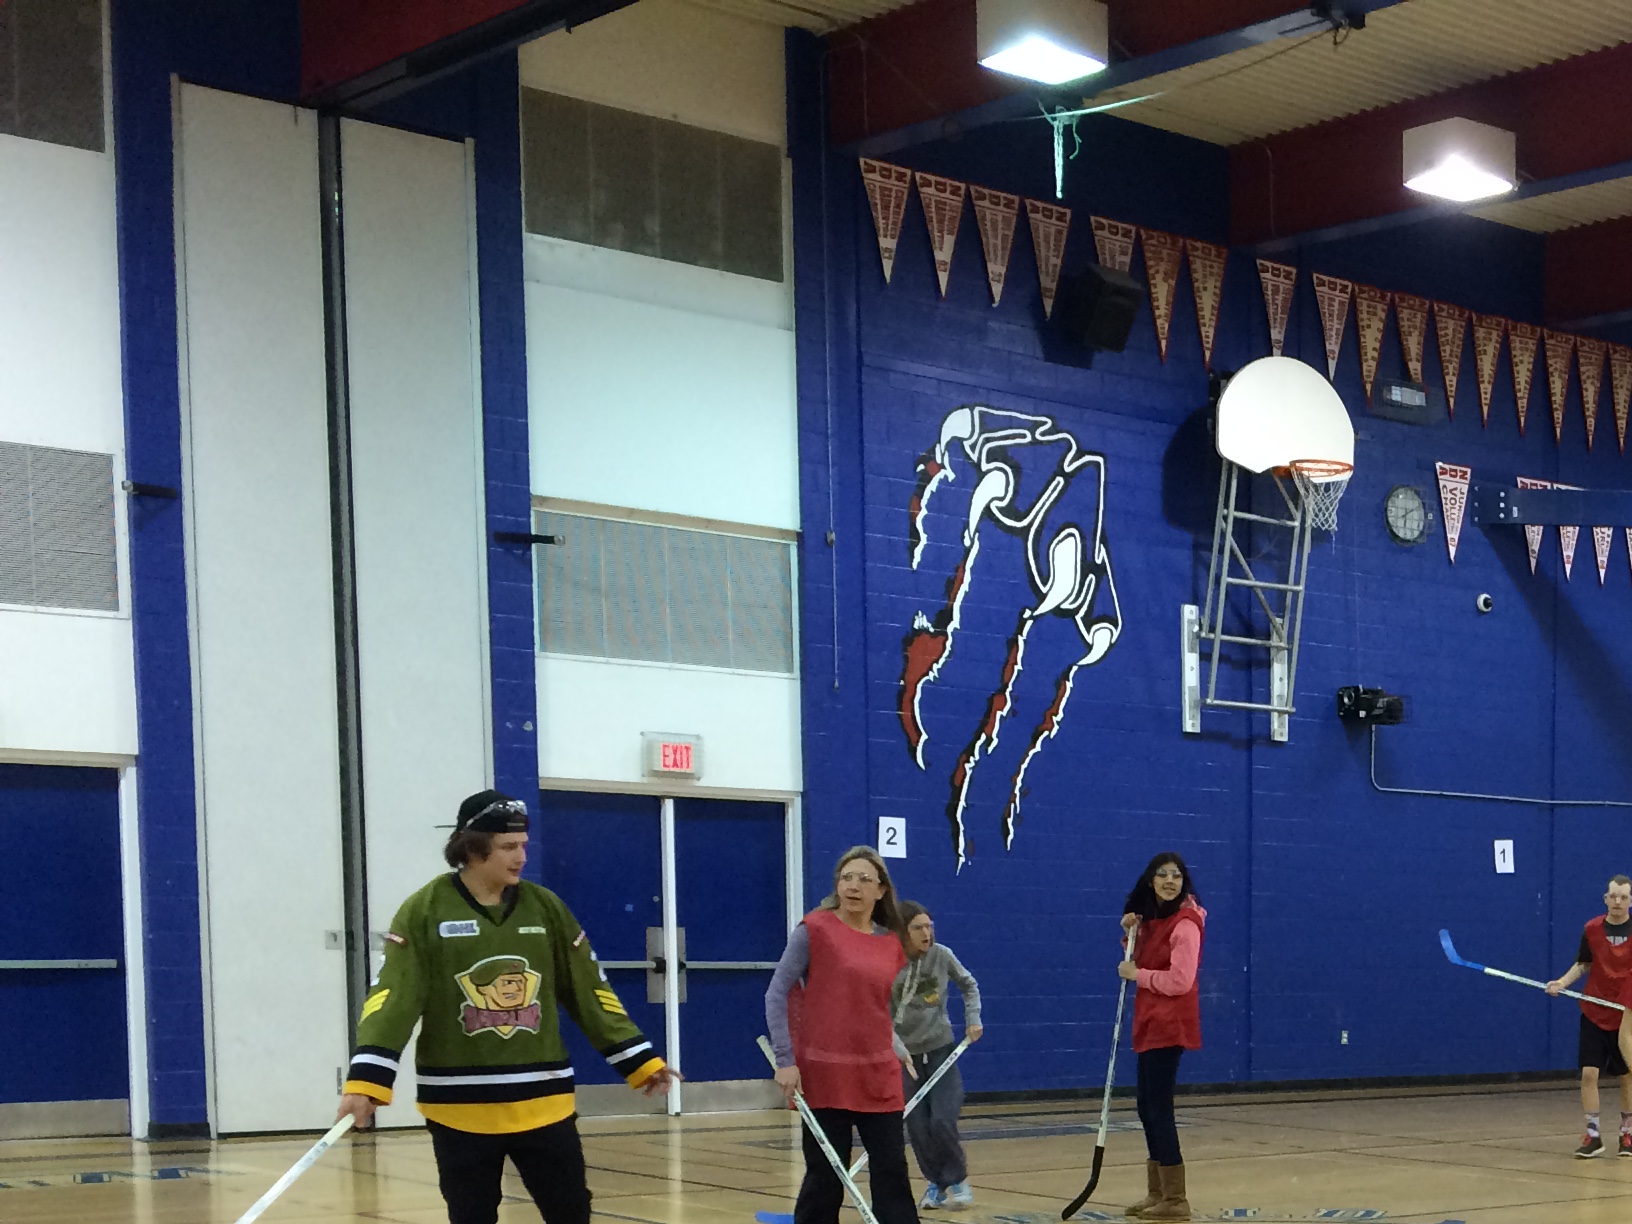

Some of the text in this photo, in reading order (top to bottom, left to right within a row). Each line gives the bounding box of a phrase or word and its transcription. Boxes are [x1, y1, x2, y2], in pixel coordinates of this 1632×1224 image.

[662, 743, 692, 770] EXIT
[885, 826, 898, 846] 2
[1499, 847, 1506, 864] 1
